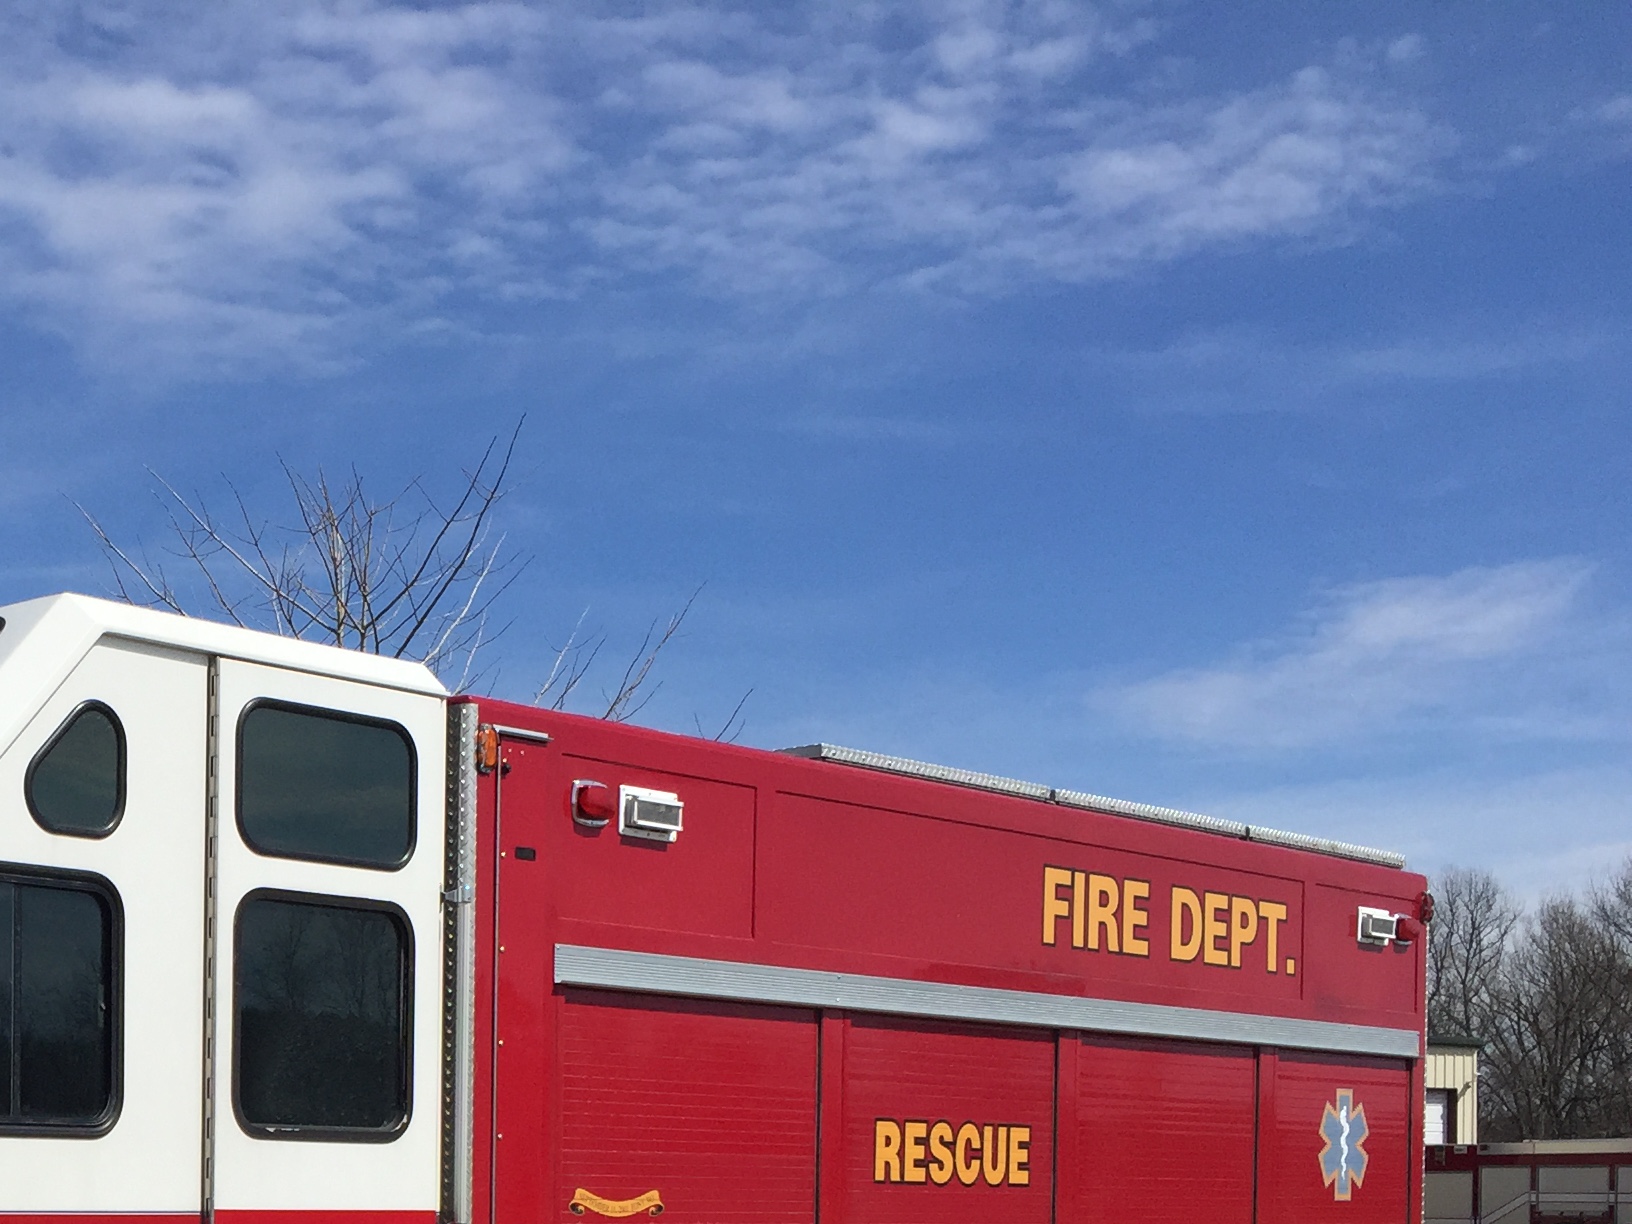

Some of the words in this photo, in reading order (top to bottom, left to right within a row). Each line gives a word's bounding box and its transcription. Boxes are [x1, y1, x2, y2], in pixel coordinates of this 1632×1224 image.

[1042, 864, 1151, 958] FIRE
[1170, 884, 1296, 976] DEPT.
[874, 1118, 1031, 1187] RESCUE
